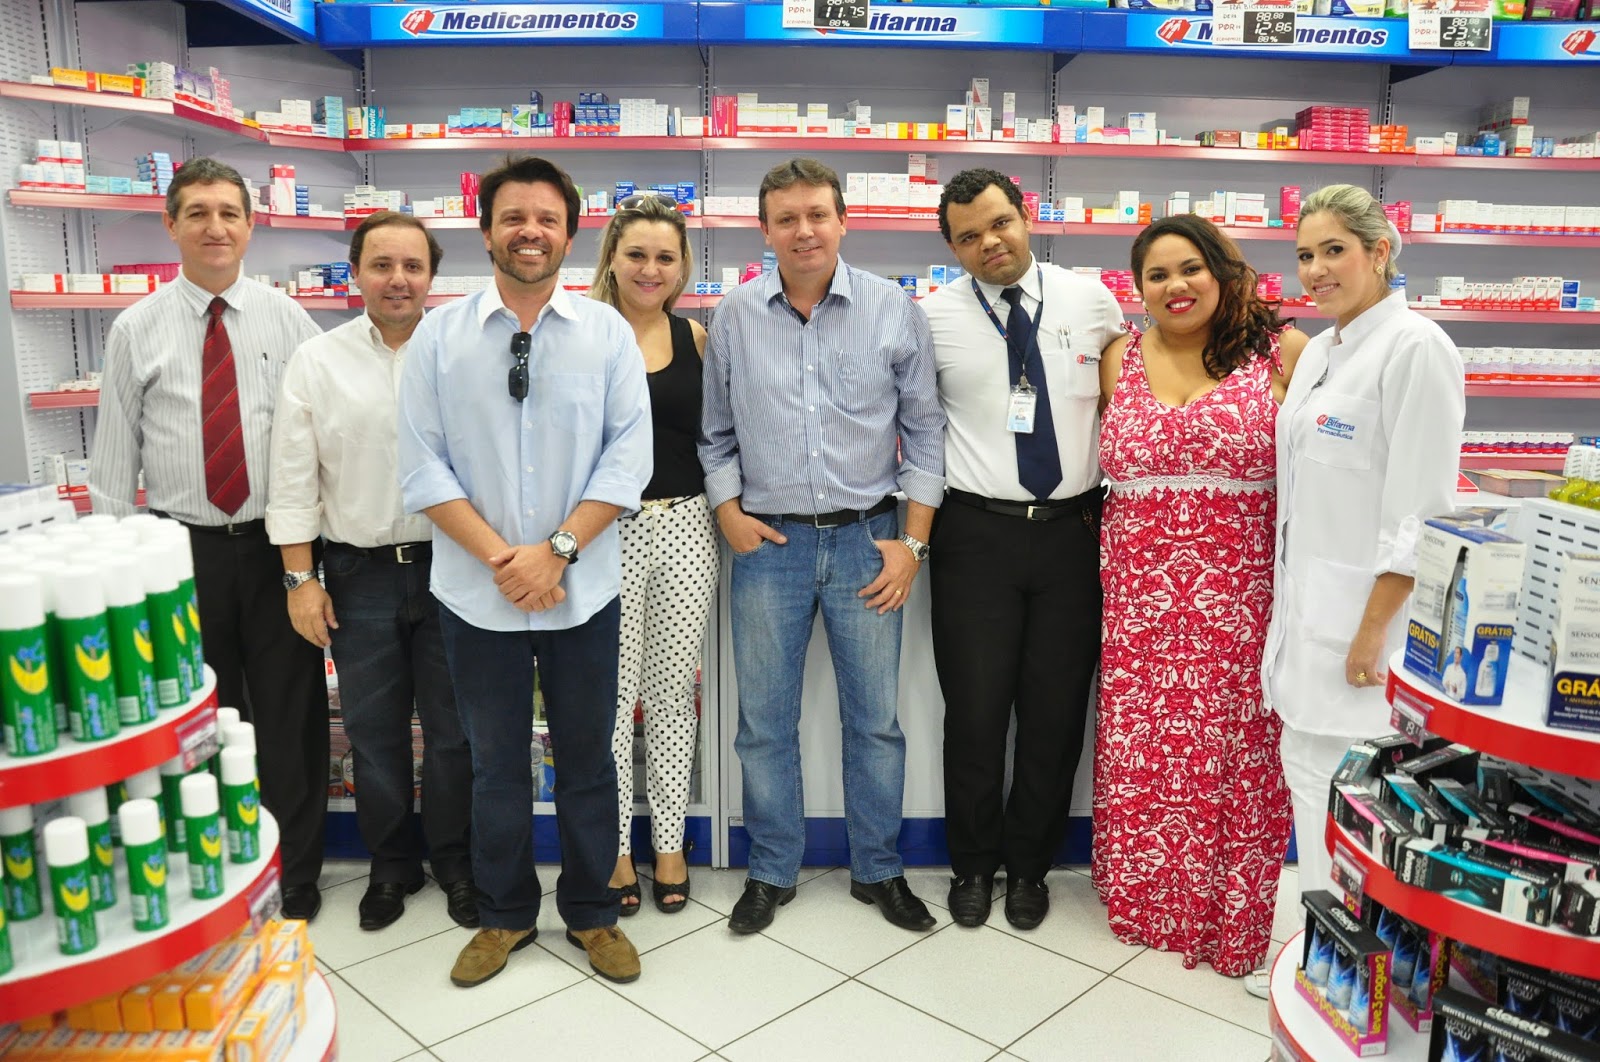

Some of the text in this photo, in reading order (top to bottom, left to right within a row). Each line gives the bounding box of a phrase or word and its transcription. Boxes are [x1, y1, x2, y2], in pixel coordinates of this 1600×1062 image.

[442, 11, 637, 31] Medicamentos
[868, 12, 957, 32] ifarma
[1254, 22, 1293, 36] 12.86
[1197, 22, 1388, 47] Mmentos
[368, 108, 377, 138] Neovite
[1326, 418, 1355, 431] Bifarma
[1477, 625, 1512, 637] GRÁTIS
[1402, 850, 1415, 883] closeup
[1331, 907, 1360, 933] closeup
[1442, 1004, 1465, 1020] DENTES
[1465, 1014, 1482, 1026] MAIS
[1482, 1021, 1512, 1039] BRANCOS
[1512, 1033, 1523, 1044] EM
[1523, 1037, 1539, 1050] UMA
[1444, 1022, 1471, 1041] NOW
[1486, 1007, 1550, 1038] closeup
[1496, 1044, 1526, 1062] NOW
